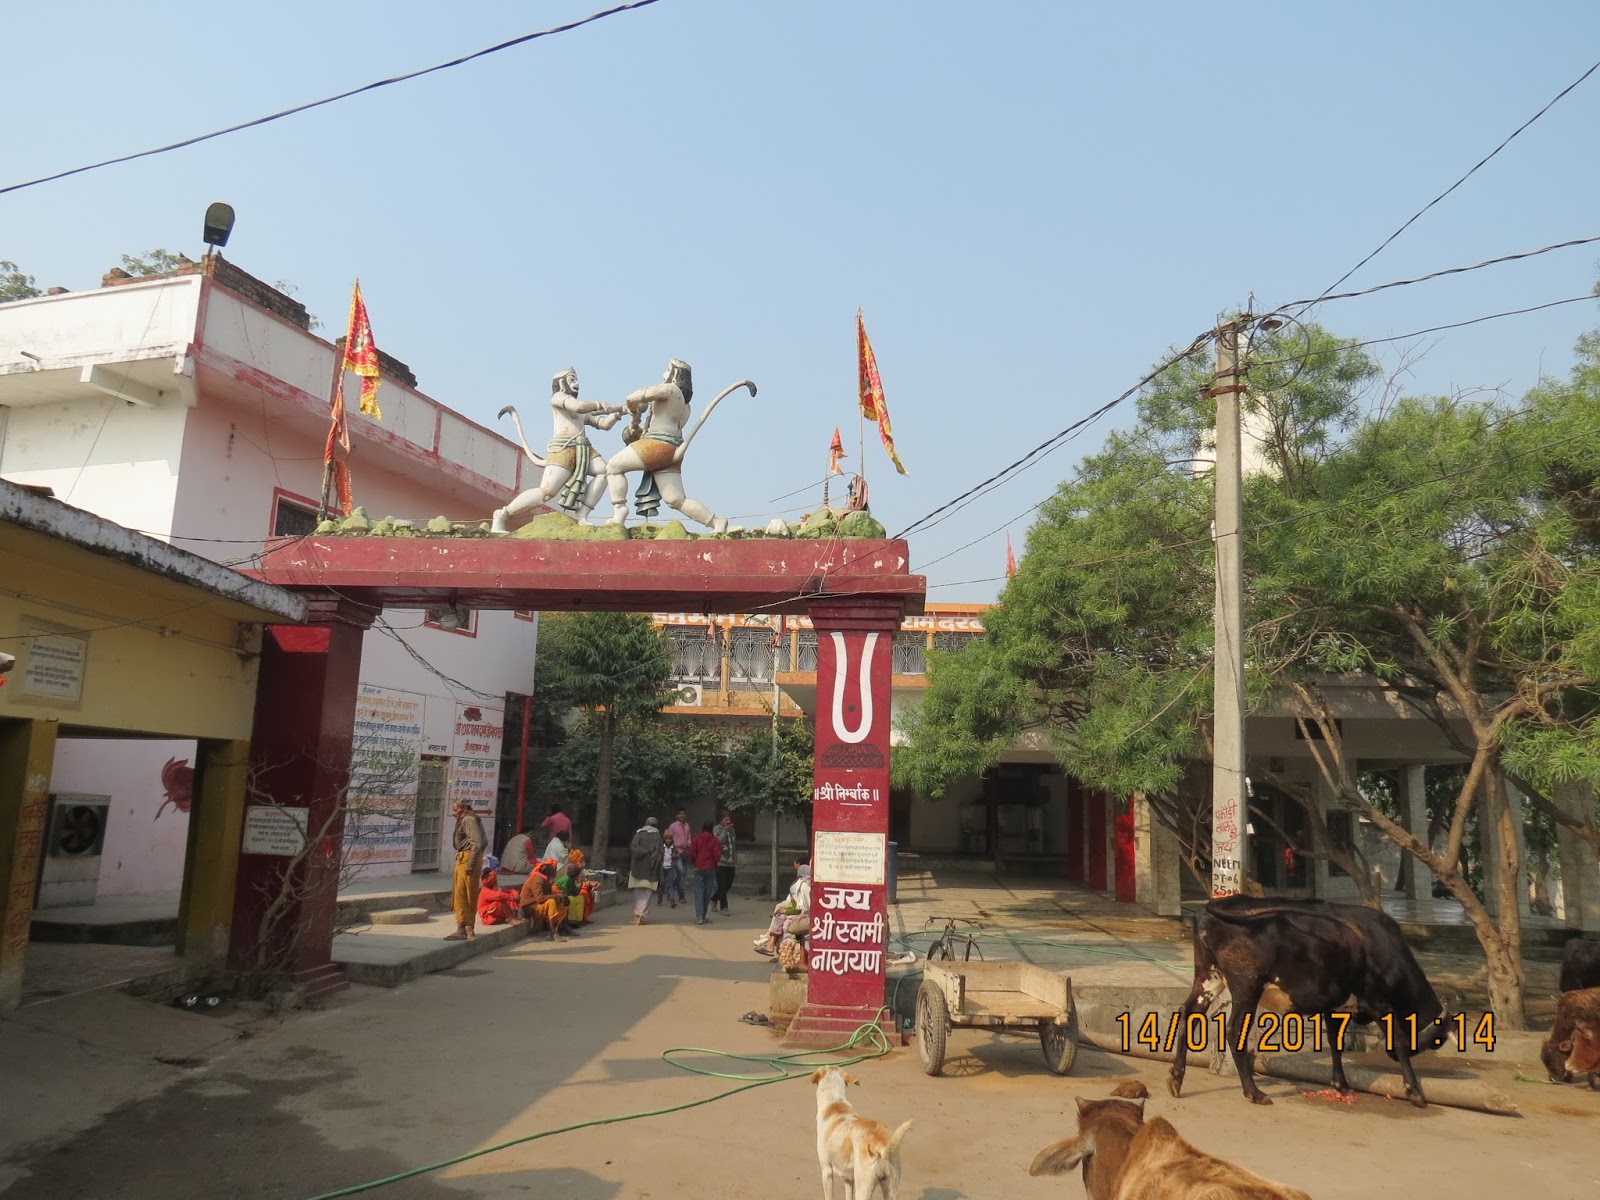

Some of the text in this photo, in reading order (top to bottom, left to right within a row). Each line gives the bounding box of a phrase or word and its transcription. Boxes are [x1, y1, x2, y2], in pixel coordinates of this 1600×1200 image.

[819, 887, 872, 910] जय
[811, 911, 884, 943] श्री स्वामी
[811, 948, 882, 975] नारायण
